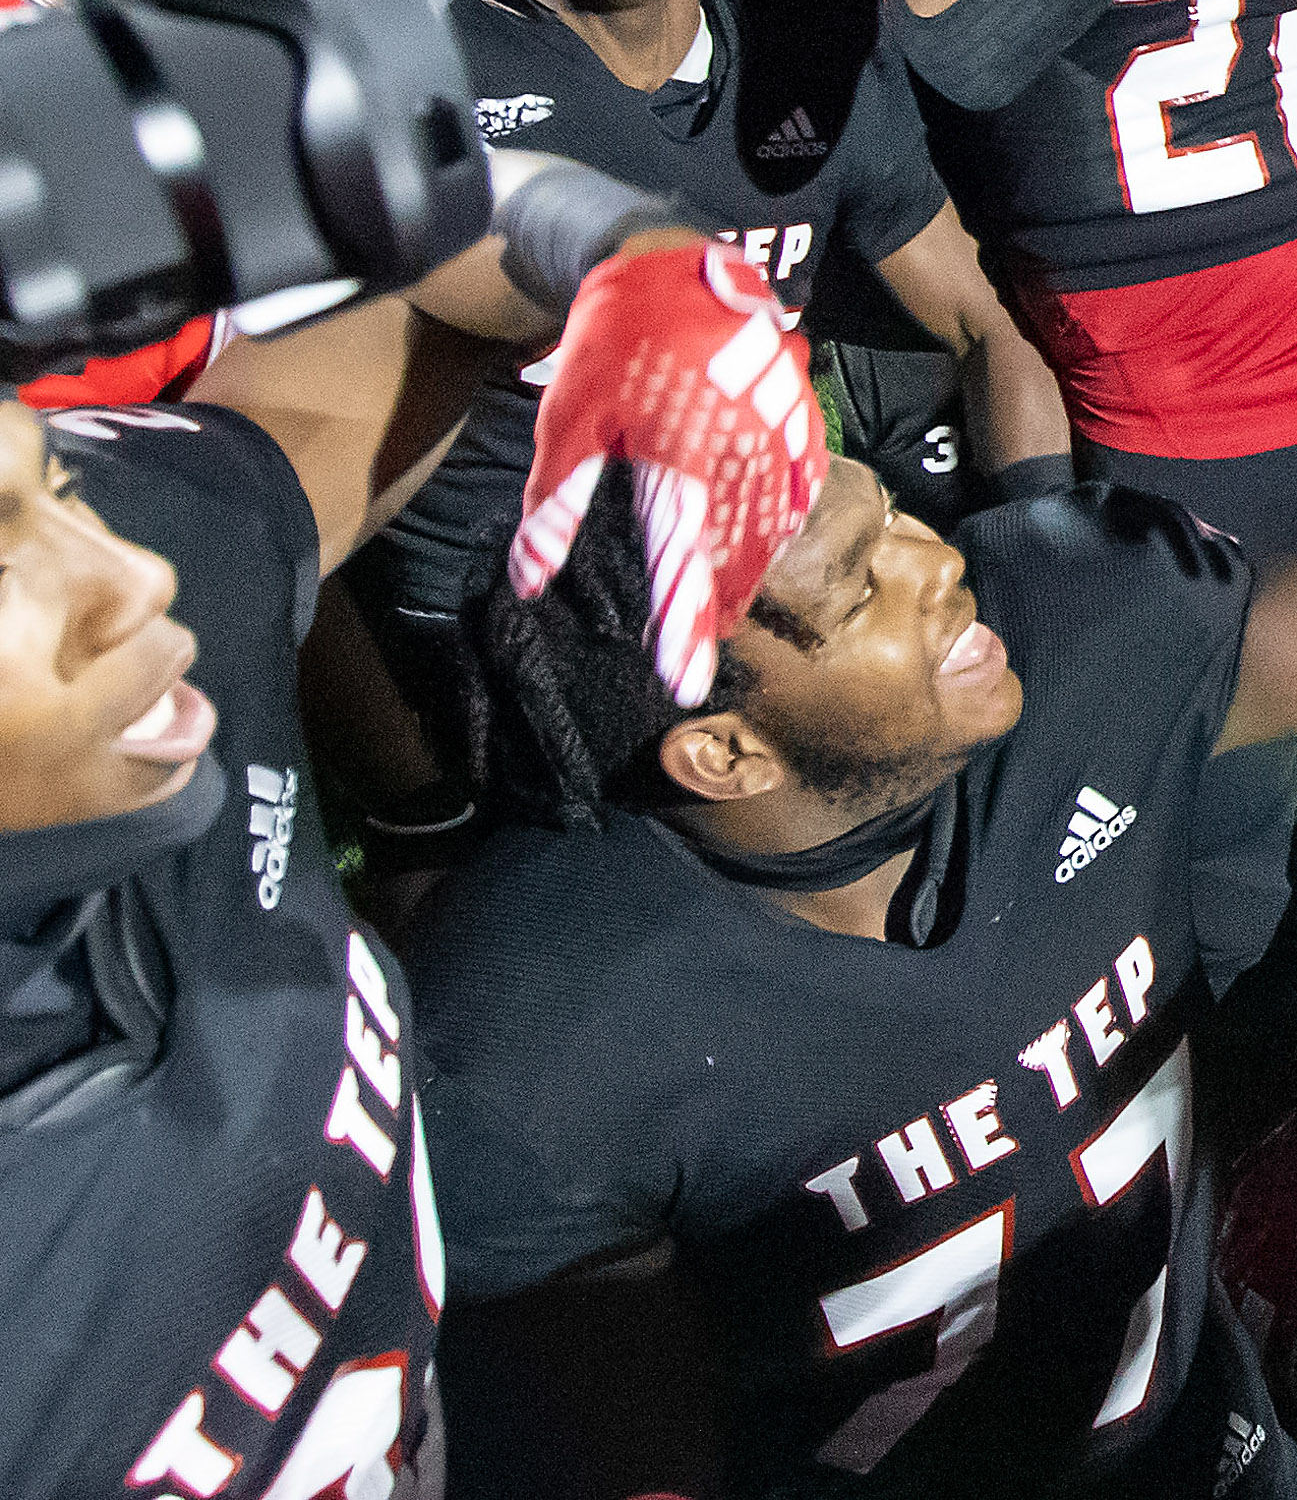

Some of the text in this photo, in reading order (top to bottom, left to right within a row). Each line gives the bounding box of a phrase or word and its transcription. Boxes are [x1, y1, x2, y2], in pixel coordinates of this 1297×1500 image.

[717, 223, 813, 281] EP
[1055, 803, 1137, 884] adidas
[124, 1183, 369, 1499] THE
[324, 929, 401, 1183] TEP
[804, 934, 1157, 1232] THE TEP
[817, 1034, 1191, 1476] 77
